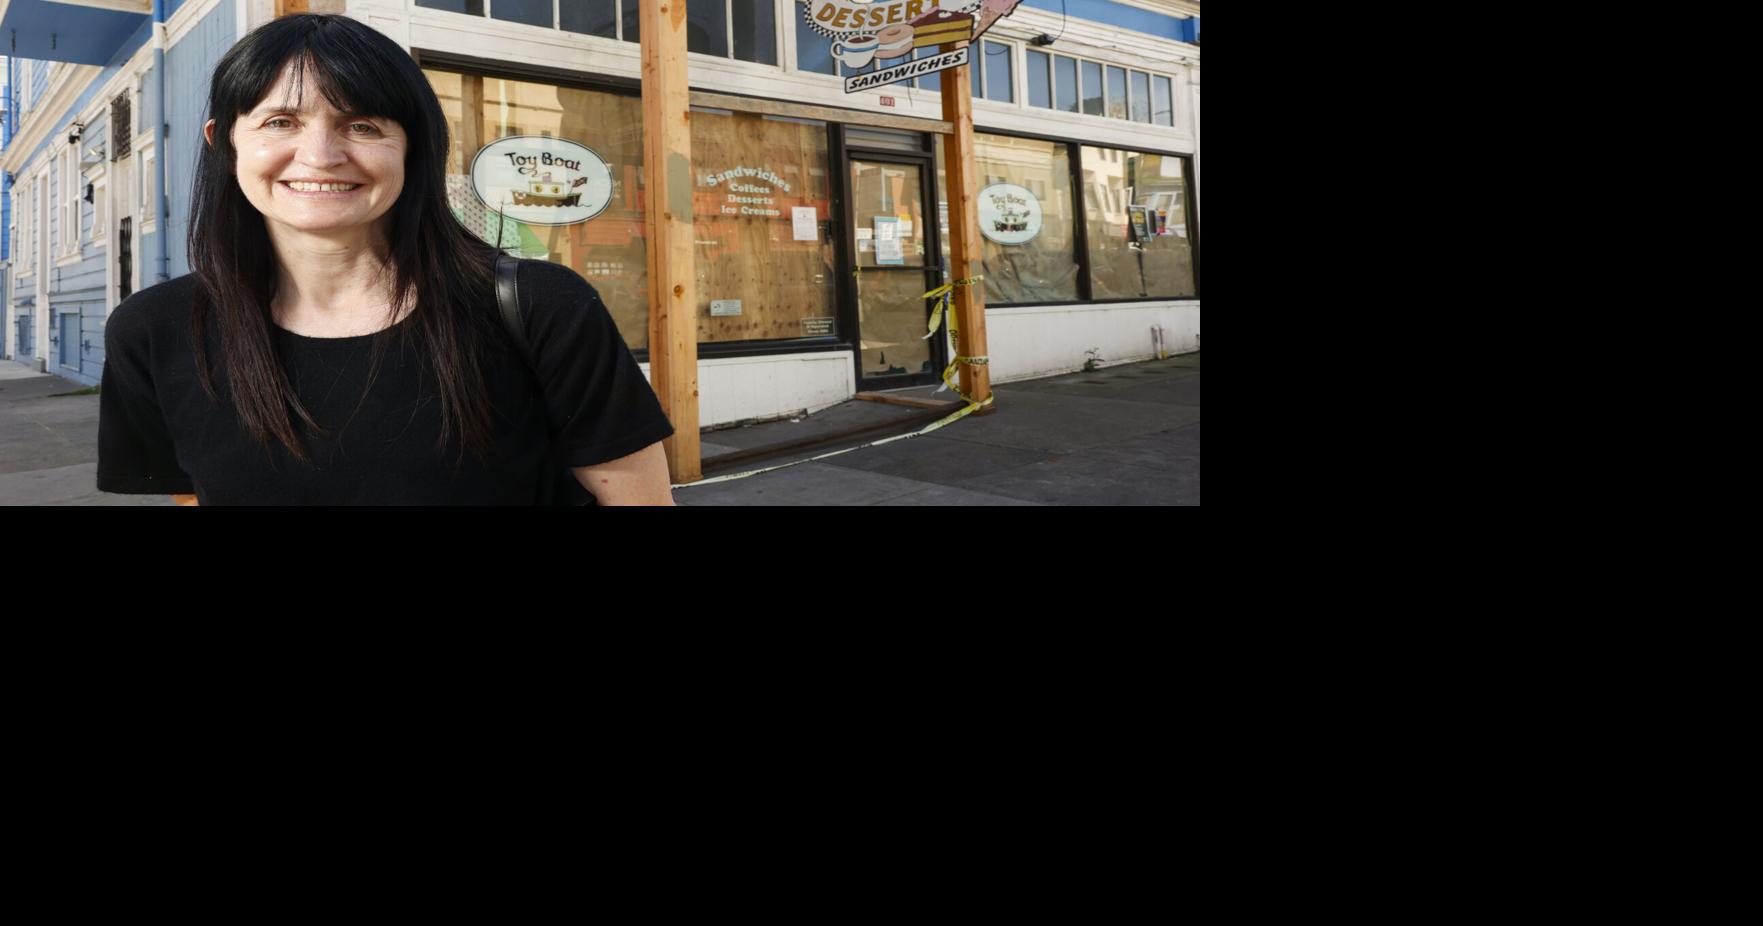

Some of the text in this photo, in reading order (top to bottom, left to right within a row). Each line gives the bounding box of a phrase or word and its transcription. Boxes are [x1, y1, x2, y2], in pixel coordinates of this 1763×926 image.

[849, 52, 964, 90] SANDWICHES
[505, 152, 581, 172] Toy Boat
[707, 166, 791, 193] Sandwiches
[730, 184, 770, 194] Coffees
[727, 194, 774, 205] Desserts
[721, 205, 780, 216] Ice Creams
